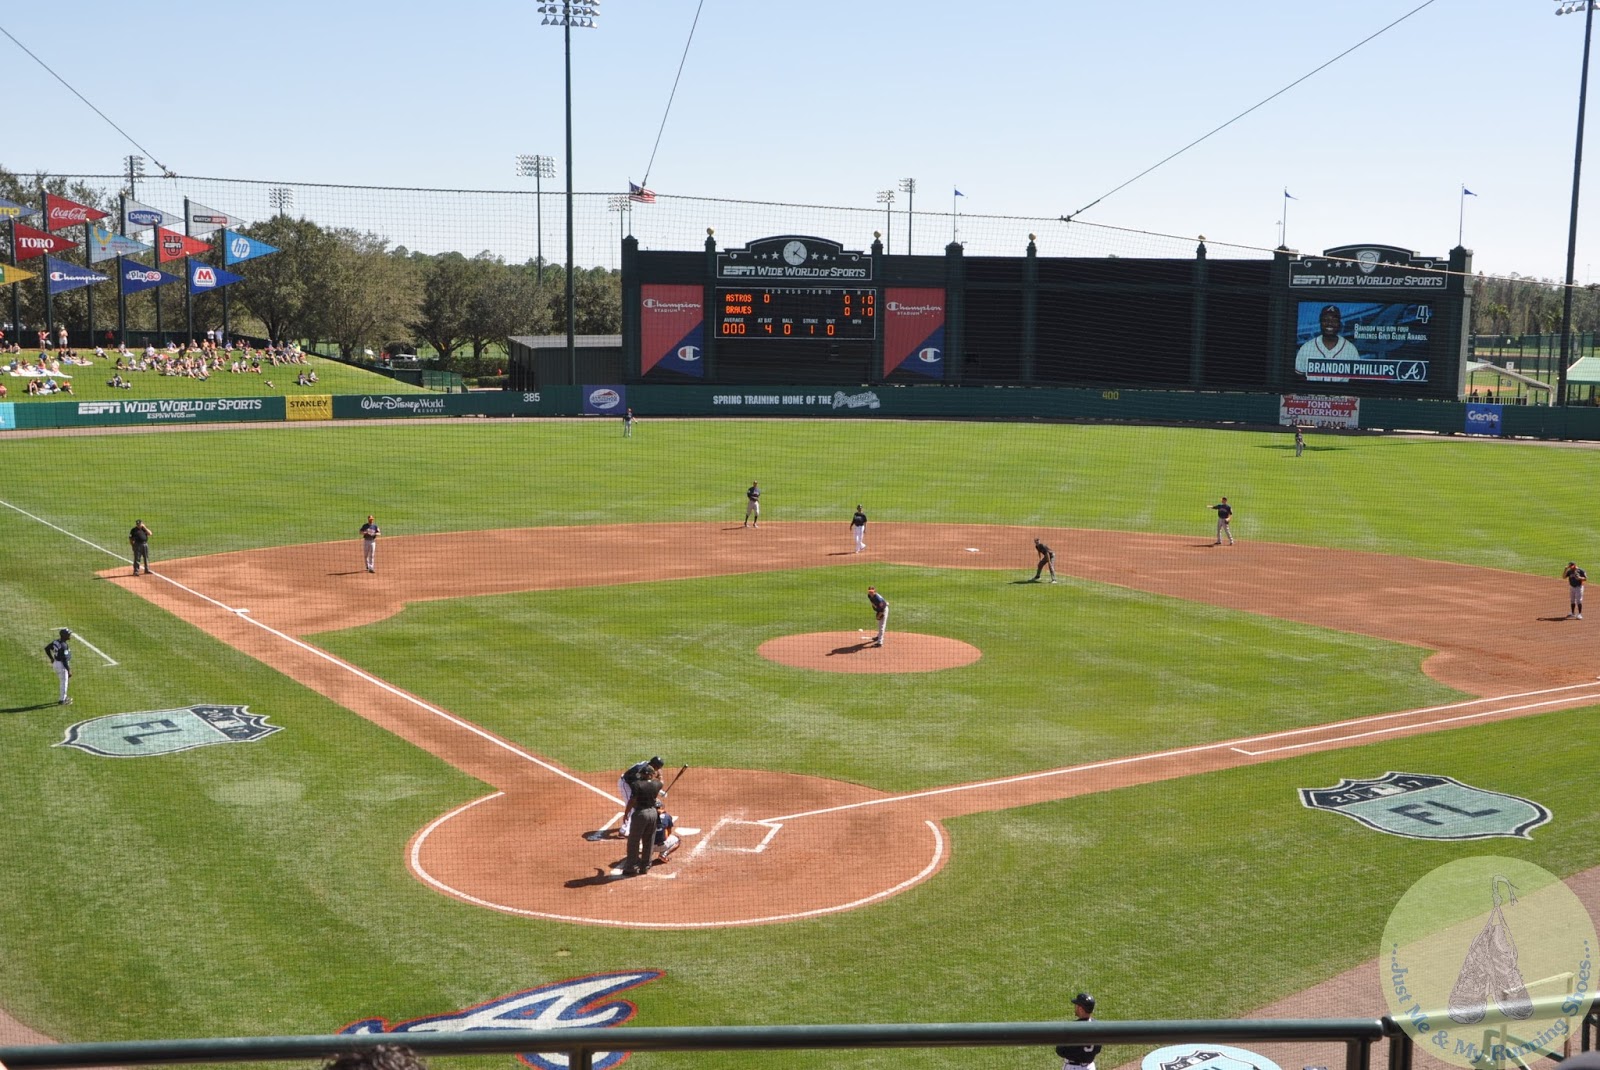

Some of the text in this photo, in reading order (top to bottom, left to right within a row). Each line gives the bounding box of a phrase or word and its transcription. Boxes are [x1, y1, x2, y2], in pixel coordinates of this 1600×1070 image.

[19, 238, 54, 248] TORO
[233, 239, 248, 257] hp
[197, 270, 212, 280] M
[723, 265, 756, 275] ESPN
[50, 272, 108, 284] Champion
[1293, 275, 1325, 285] ESPN
[726, 294, 752, 302] ASTROS
[764, 294, 770, 303] 0
[844, 295, 851, 304] 0
[643, 298, 701, 311] Champion
[886, 302, 942, 313] Champion
[726, 306, 752, 314] BRAVES
[844, 307, 851, 316] 0
[1416, 305, 1429, 324] 4
[722, 323, 745, 334] 000
[765, 324, 772, 334] 4
[784, 324, 791, 335] 0
[827, 324, 834, 335] 0
[1308, 362, 1350, 373] BRANDON
[1353, 363, 1395, 376] PHILLIPS
[523, 393, 540, 402] 385
[713, 395, 737, 405] SPRING
[744, 395, 779, 405] TRAINING
[782, 395, 803, 405] HOME
[806, 396, 816, 405] OF
[818, 396, 831, 405] THE
[1102, 391, 1118, 400] 400
[78, 402, 121, 414] ESPN
[123, 401, 158, 413] WIDE
[159, 400, 203, 412] WORLD
[218, 399, 262, 410] SPORTS
[290, 400, 328, 408] STANLEY
[419, 398, 444, 408] World
[1308, 401, 1331, 409] JOHN
[1289, 407, 1349, 417] SCHUERHOLZ
[1468, 410, 1499, 421] Genie
[1387, 800, 1500, 826] FL
